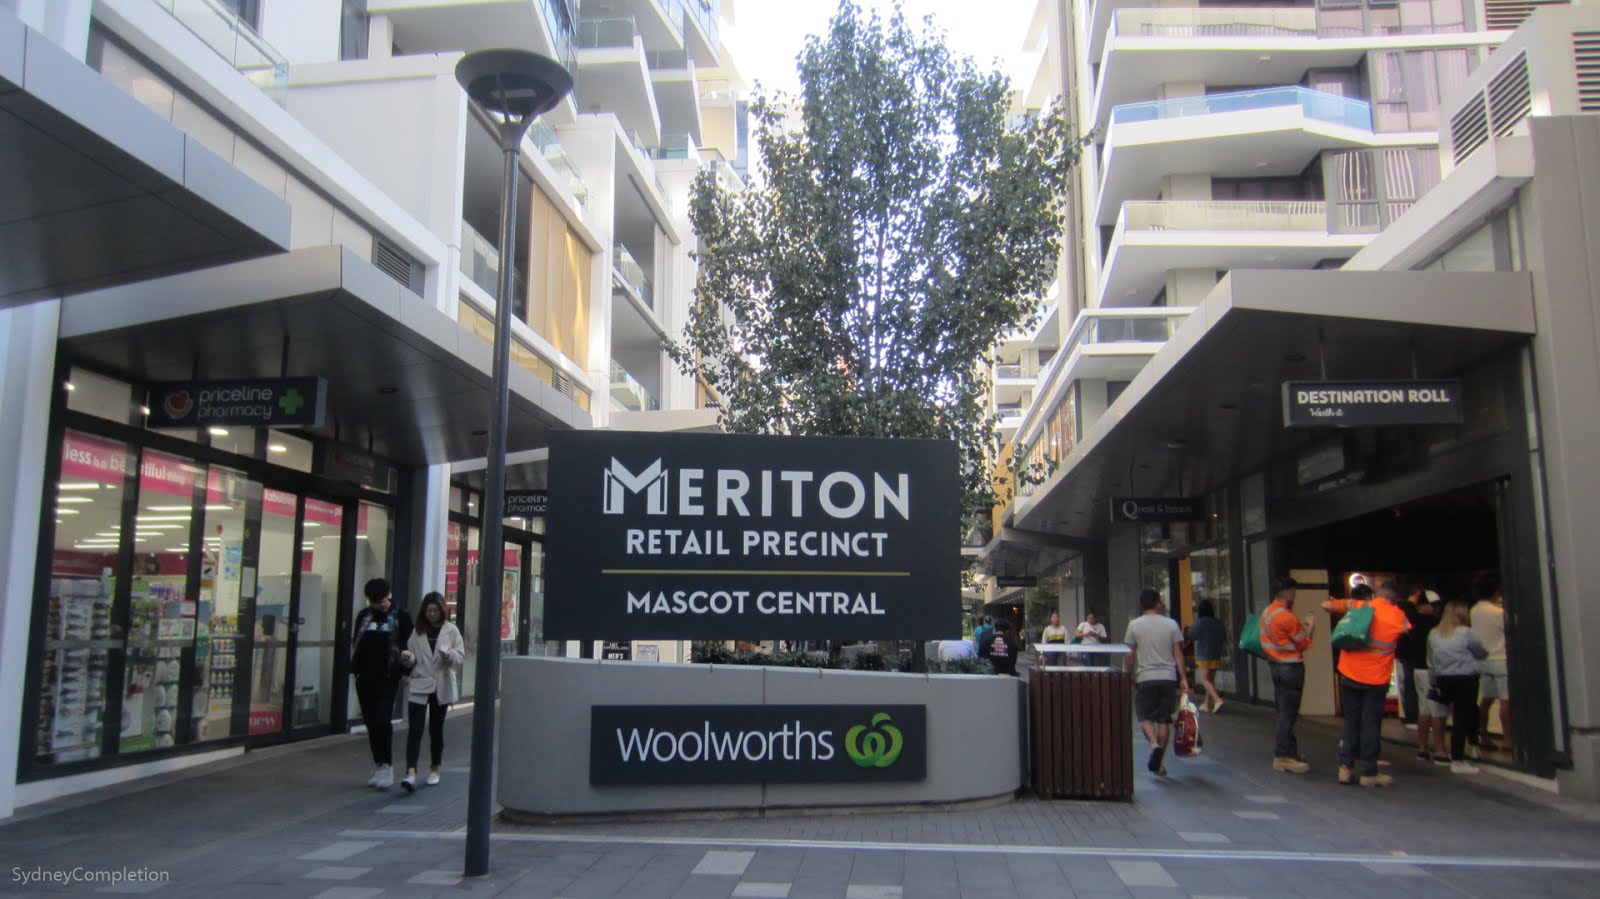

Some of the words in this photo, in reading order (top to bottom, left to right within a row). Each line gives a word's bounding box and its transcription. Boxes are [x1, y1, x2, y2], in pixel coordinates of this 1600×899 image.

[200, 386, 273, 404] priceline
[1297, 389, 1404, 405] DESTINATION
[1407, 388, 1450, 403] ROLL
[198, 404, 273, 420] pharmacy
[603, 455, 910, 521] MERITON
[626, 528, 731, 556] RETAIL
[743, 530, 888, 557] PRECINCT
[626, 590, 750, 614] MASCOT
[756, 591, 886, 615] CENTRAL
[616, 720, 835, 762] Woolworths
